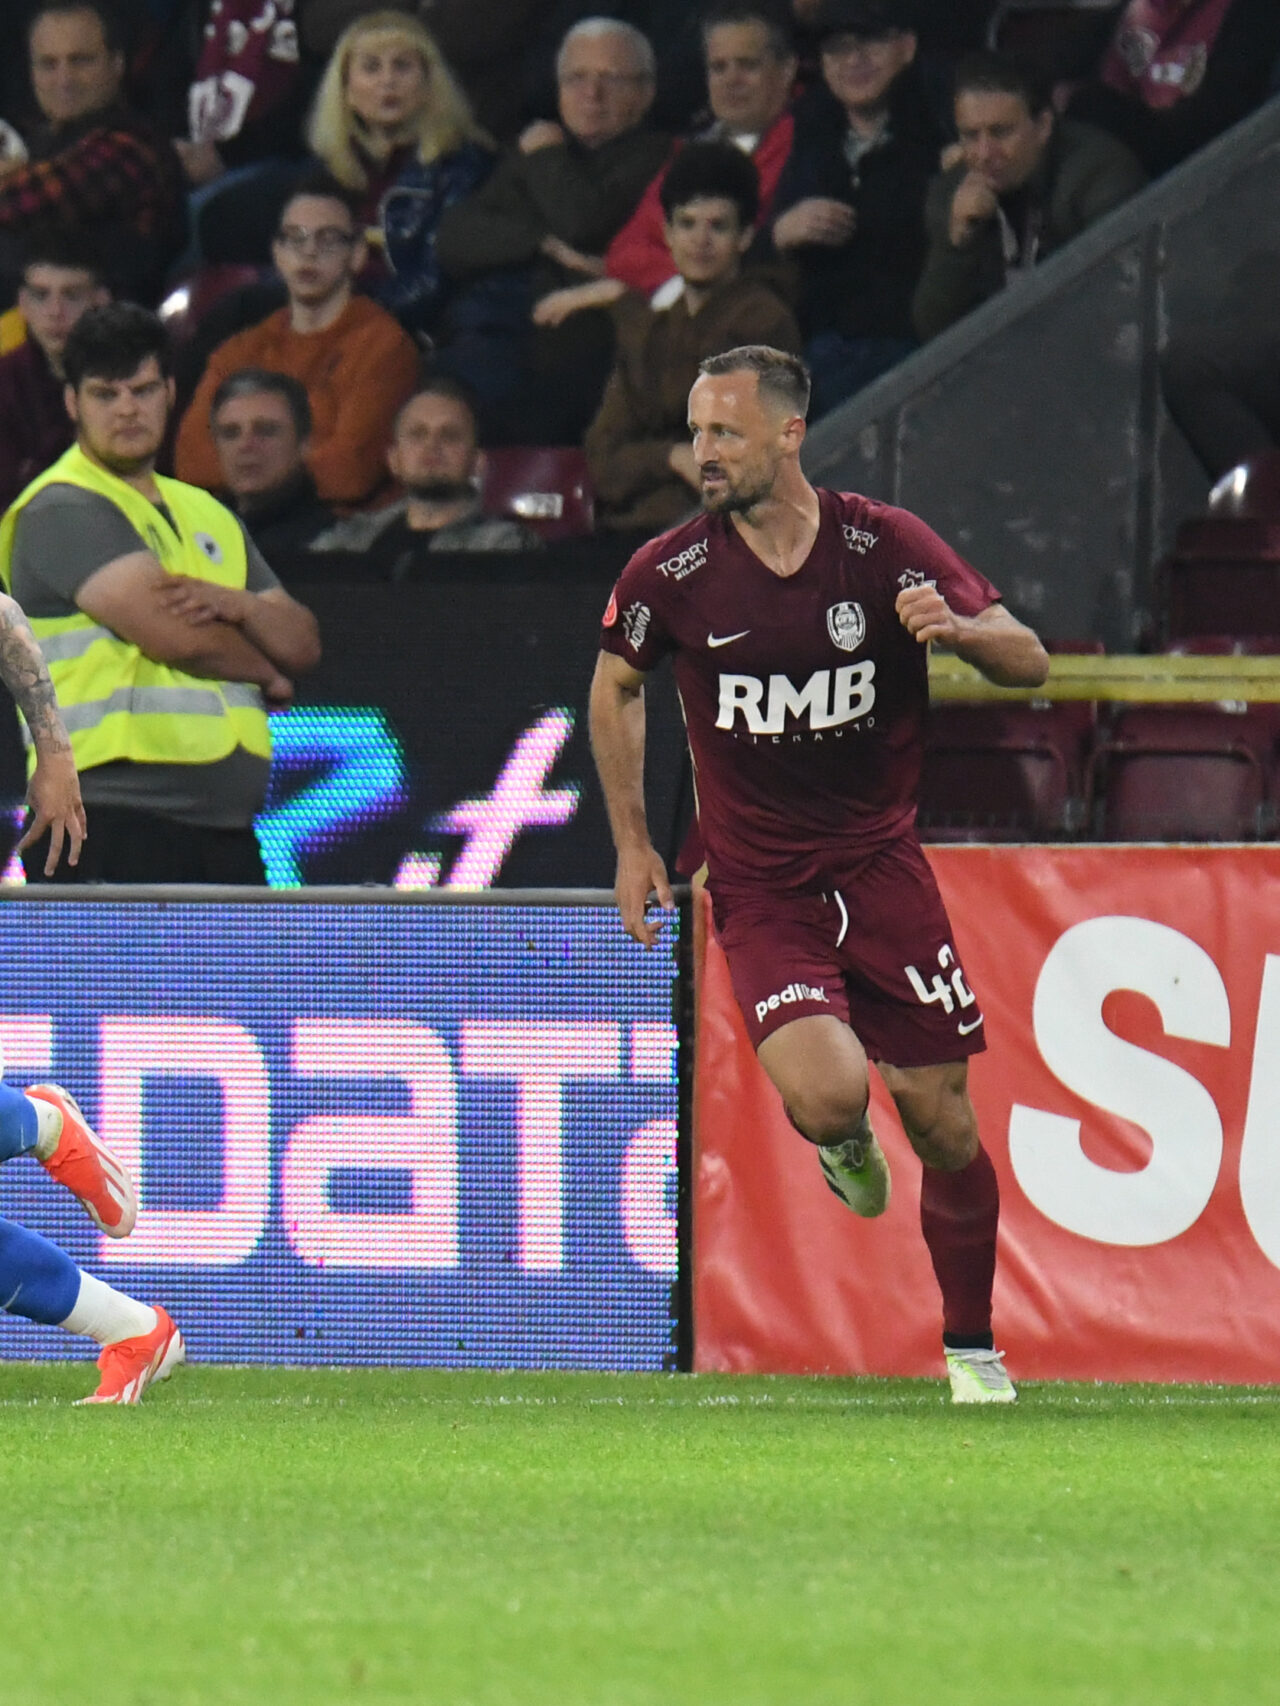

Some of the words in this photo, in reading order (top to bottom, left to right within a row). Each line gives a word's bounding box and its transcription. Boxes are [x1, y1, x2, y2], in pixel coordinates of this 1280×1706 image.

[656, 538, 709, 577] TORRY
[674, 556, 707, 581] MILANO
[715, 660, 876, 734] RMB
[904, 943, 976, 1015] 42
[1008, 915, 1280, 1270] S
